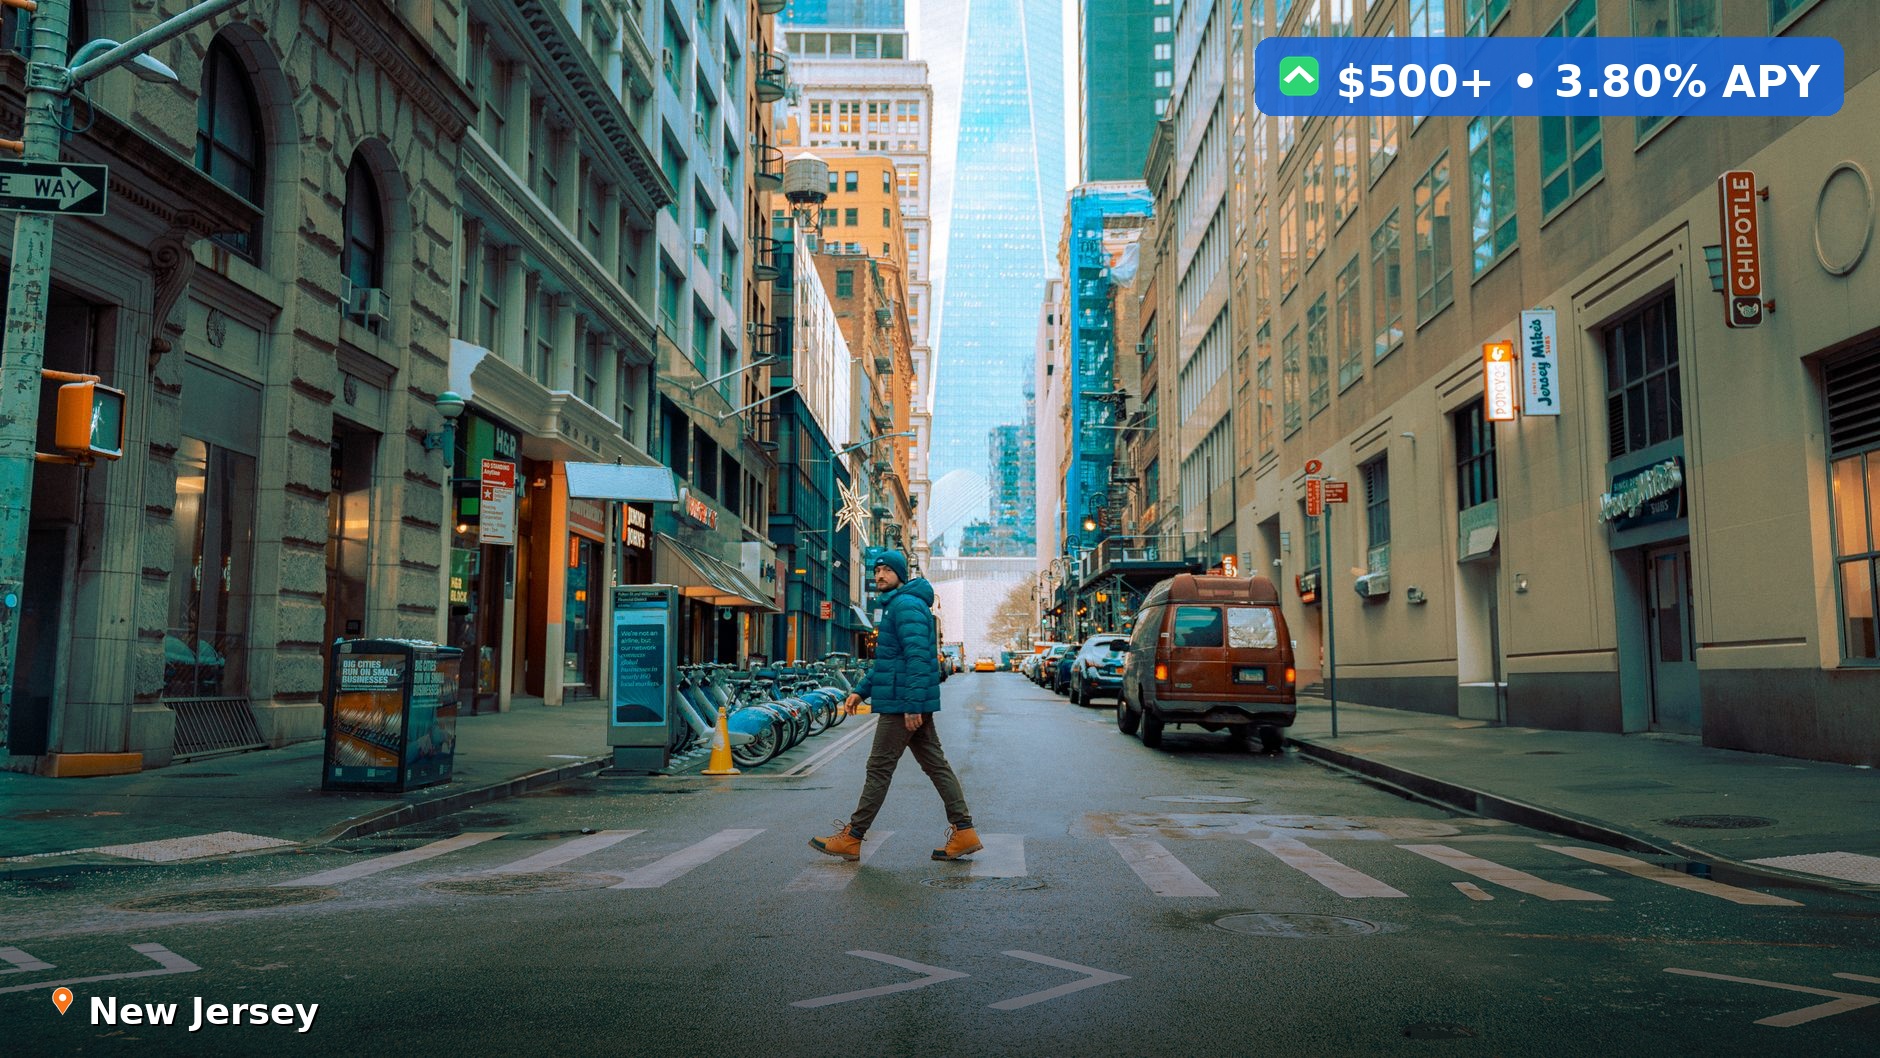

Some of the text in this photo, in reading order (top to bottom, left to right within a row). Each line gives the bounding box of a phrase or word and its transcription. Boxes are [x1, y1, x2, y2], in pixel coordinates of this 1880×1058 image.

[34, 177, 81, 198] WAY
[1733, 177, 1755, 290] CHIPOTLE
[1529, 319, 1552, 406] Jersey Mike's
[495, 427, 516, 459] H&R
[342, 668, 398, 676] RUN ON SMALL
[343, 660, 381, 668] BIG CITIES
[342, 676, 388, 684] BUSINESSES
